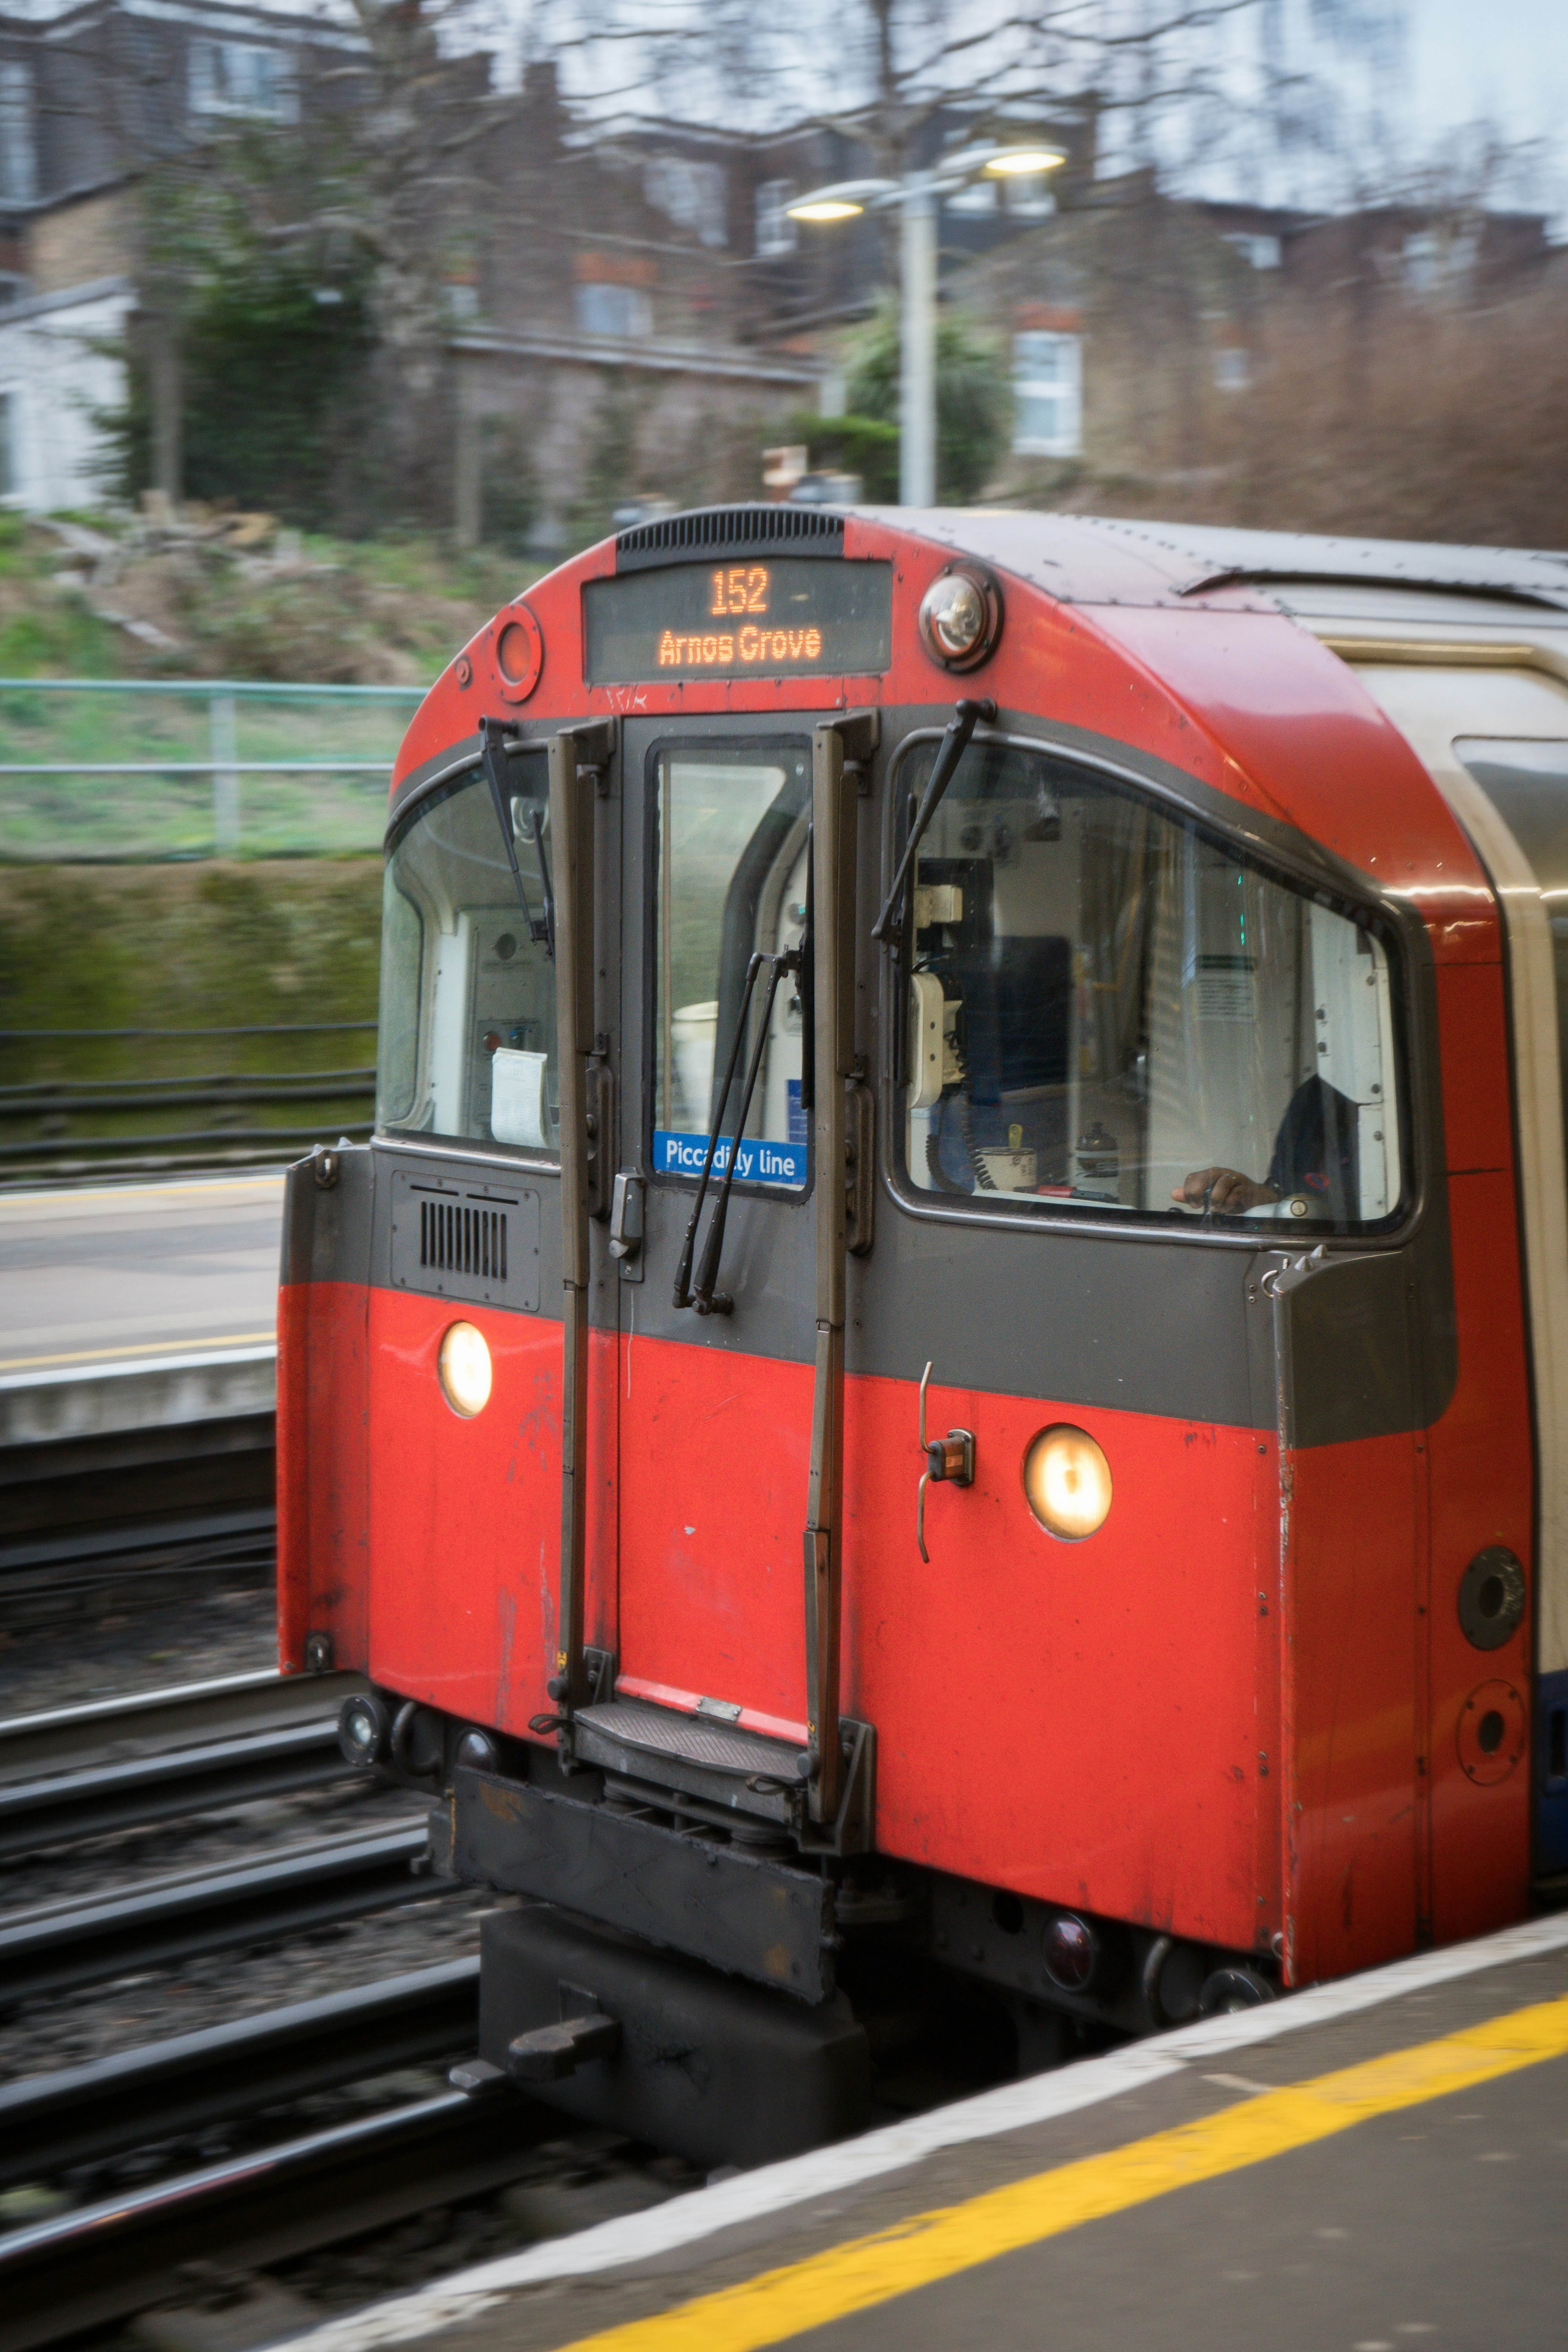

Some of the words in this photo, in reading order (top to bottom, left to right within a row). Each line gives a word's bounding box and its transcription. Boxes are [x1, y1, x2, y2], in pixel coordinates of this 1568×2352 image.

[712, 567, 767, 615] 152
[660, 630, 733, 665] Arnos
[739, 626, 821, 661] Grove
[666, 1140, 753, 1177] Piccdily
[759, 1149, 795, 1176] line
